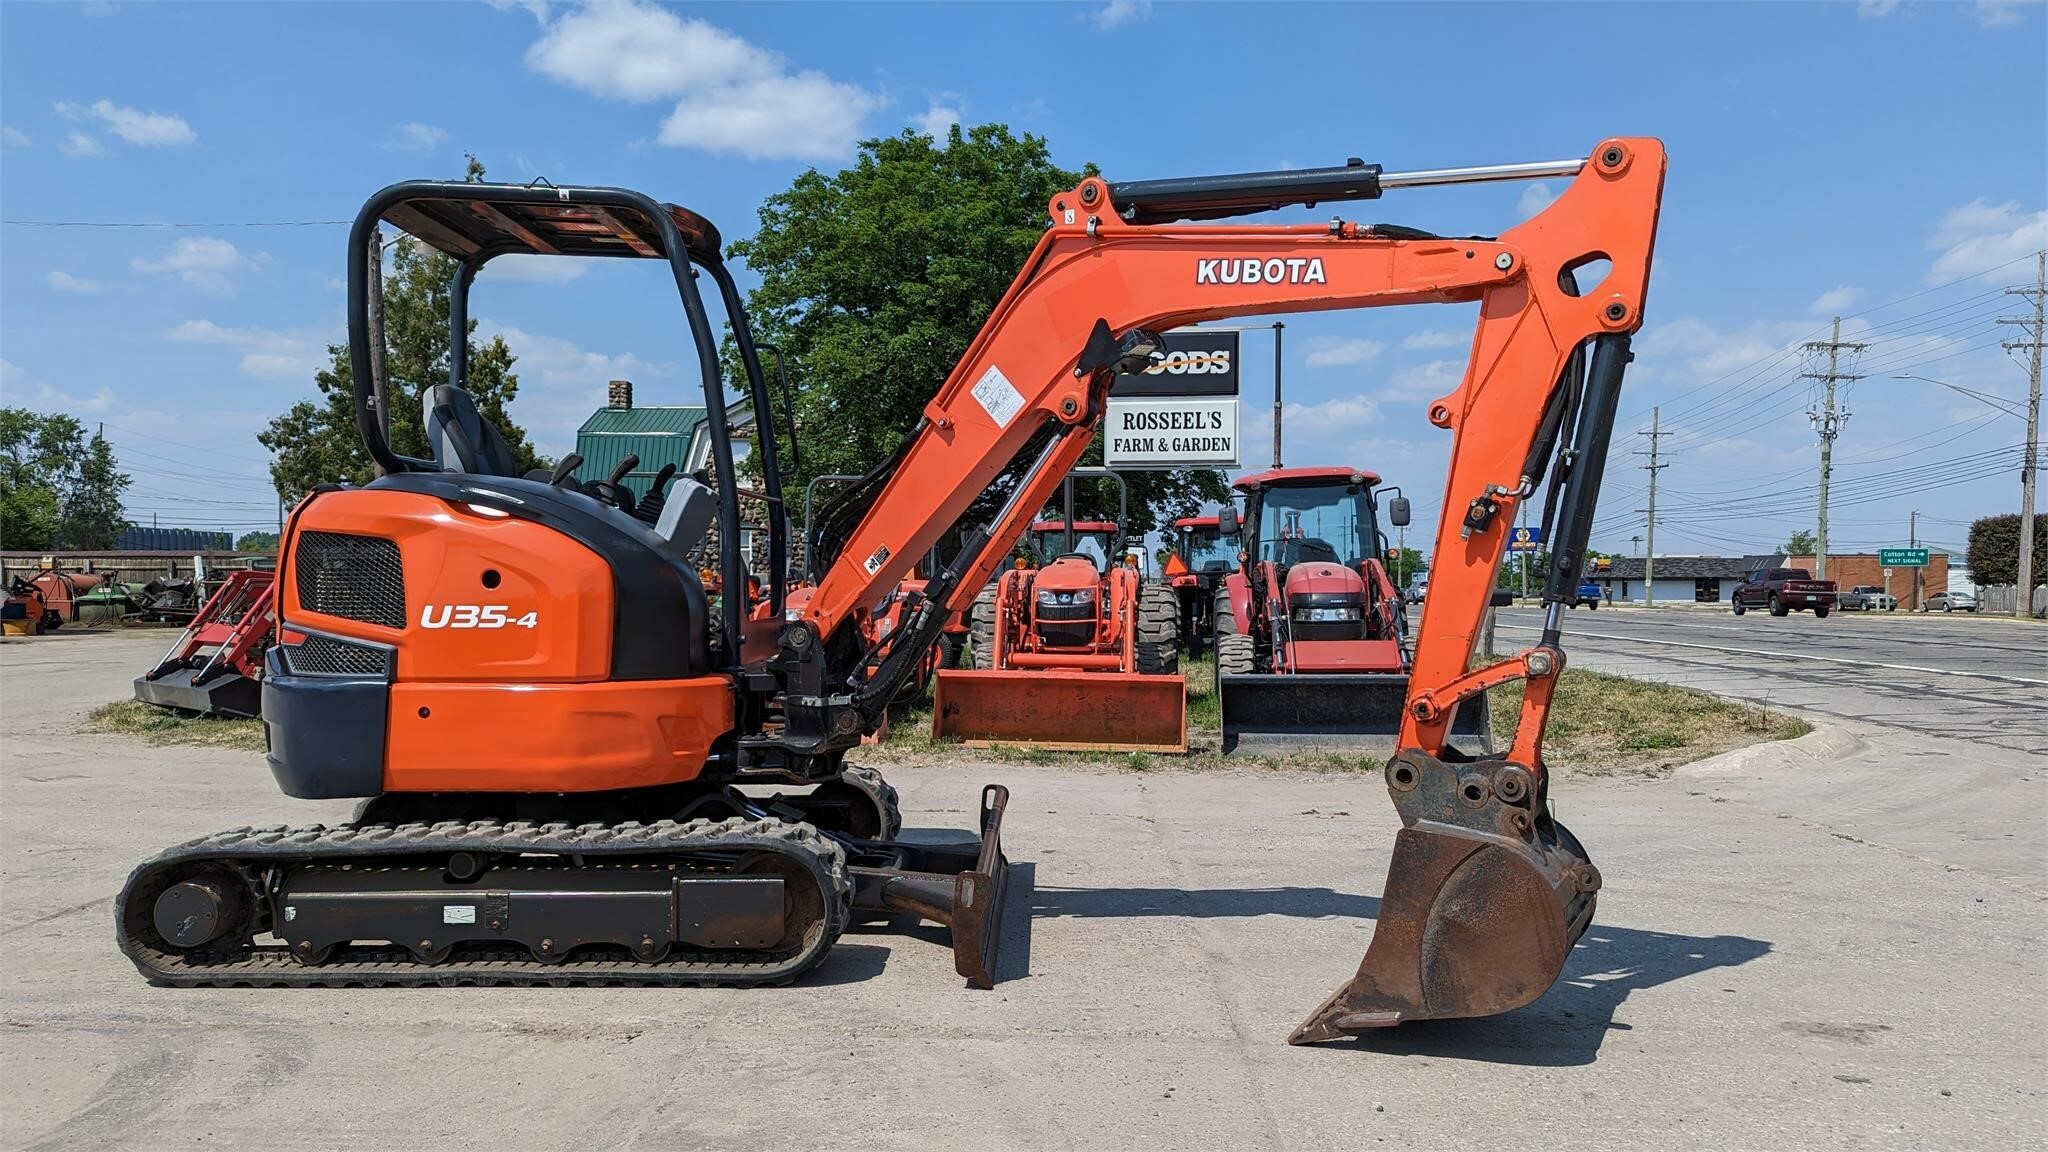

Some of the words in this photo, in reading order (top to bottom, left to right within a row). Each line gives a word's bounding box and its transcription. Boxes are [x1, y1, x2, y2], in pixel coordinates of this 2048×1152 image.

[1196, 257, 1327, 285] KUBOTA
[1146, 350, 1230, 375] OODS
[1122, 411, 1222, 430] ROSSEEL'S
[1113, 438, 1154, 452] FARM
[1158, 437, 1169, 452] &
[1172, 437, 1231, 452] GARDEN
[420, 605, 538, 629] U35-4
